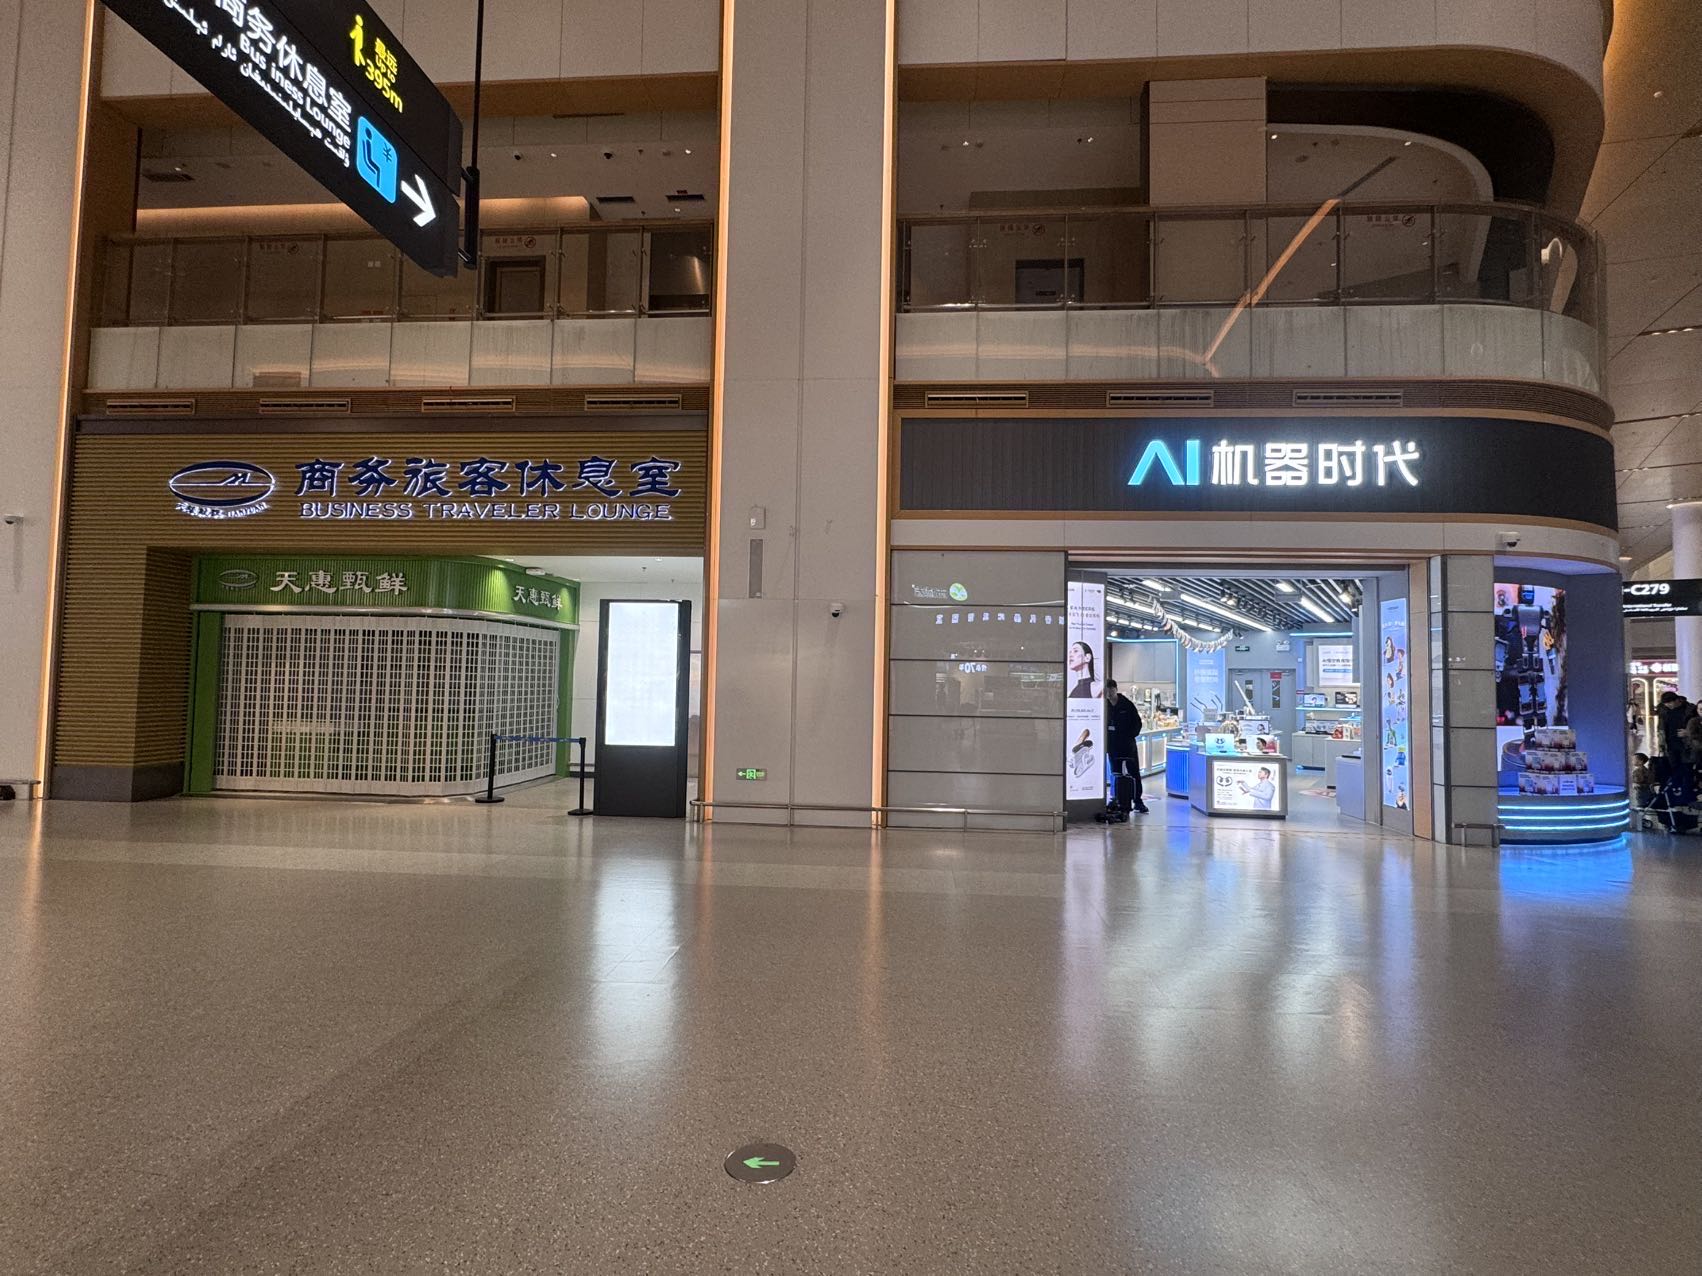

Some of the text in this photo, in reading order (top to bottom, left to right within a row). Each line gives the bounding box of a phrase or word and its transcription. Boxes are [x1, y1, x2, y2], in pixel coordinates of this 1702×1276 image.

[376, 54, 396, 84] Up to
[365, 58, 403, 114] 395m
[306, 99, 350, 149] Lounge
[294, 456, 682, 498] 商务旅客休息室
[299, 502, 673, 521] BUSINESS TRAVELER LOUNGE
[270, 570, 408, 595] 天惠甄鲜
[1621, 583, 1671, 595] -C279
